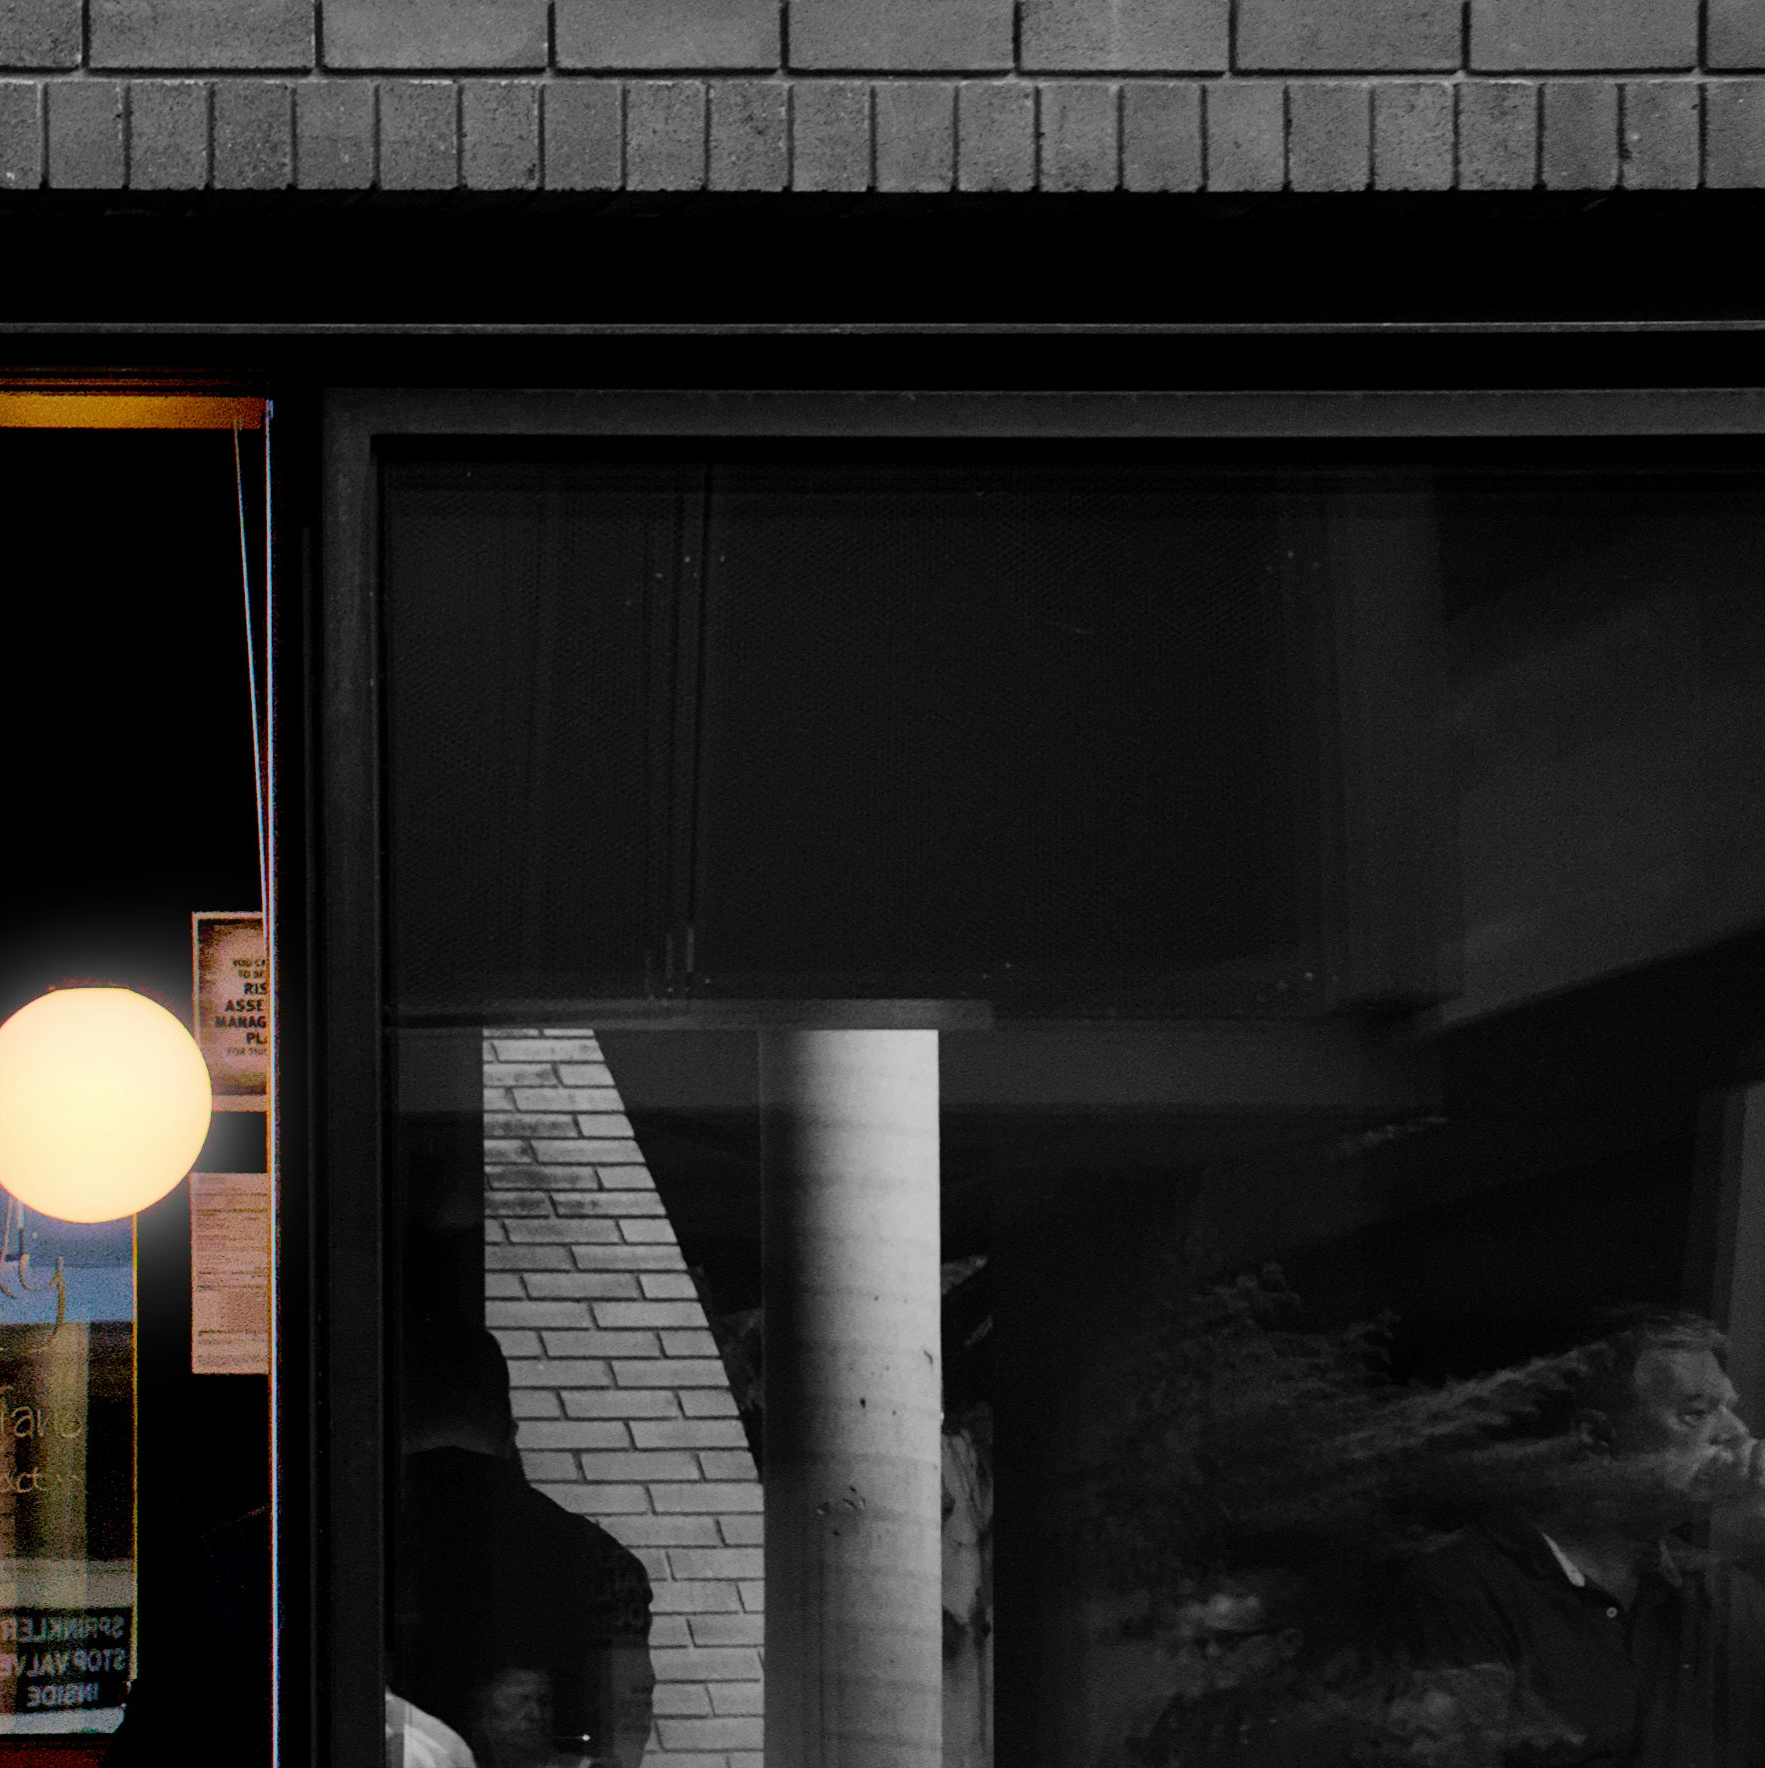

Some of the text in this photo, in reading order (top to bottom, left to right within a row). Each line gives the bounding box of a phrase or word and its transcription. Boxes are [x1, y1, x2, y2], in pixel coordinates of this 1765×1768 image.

[244, 983, 267, 995] RIS
[225, 1000, 265, 1012] ASSE
[214, 1016, 267, 1029] MANAG
[246, 1032, 267, 1044] PL
